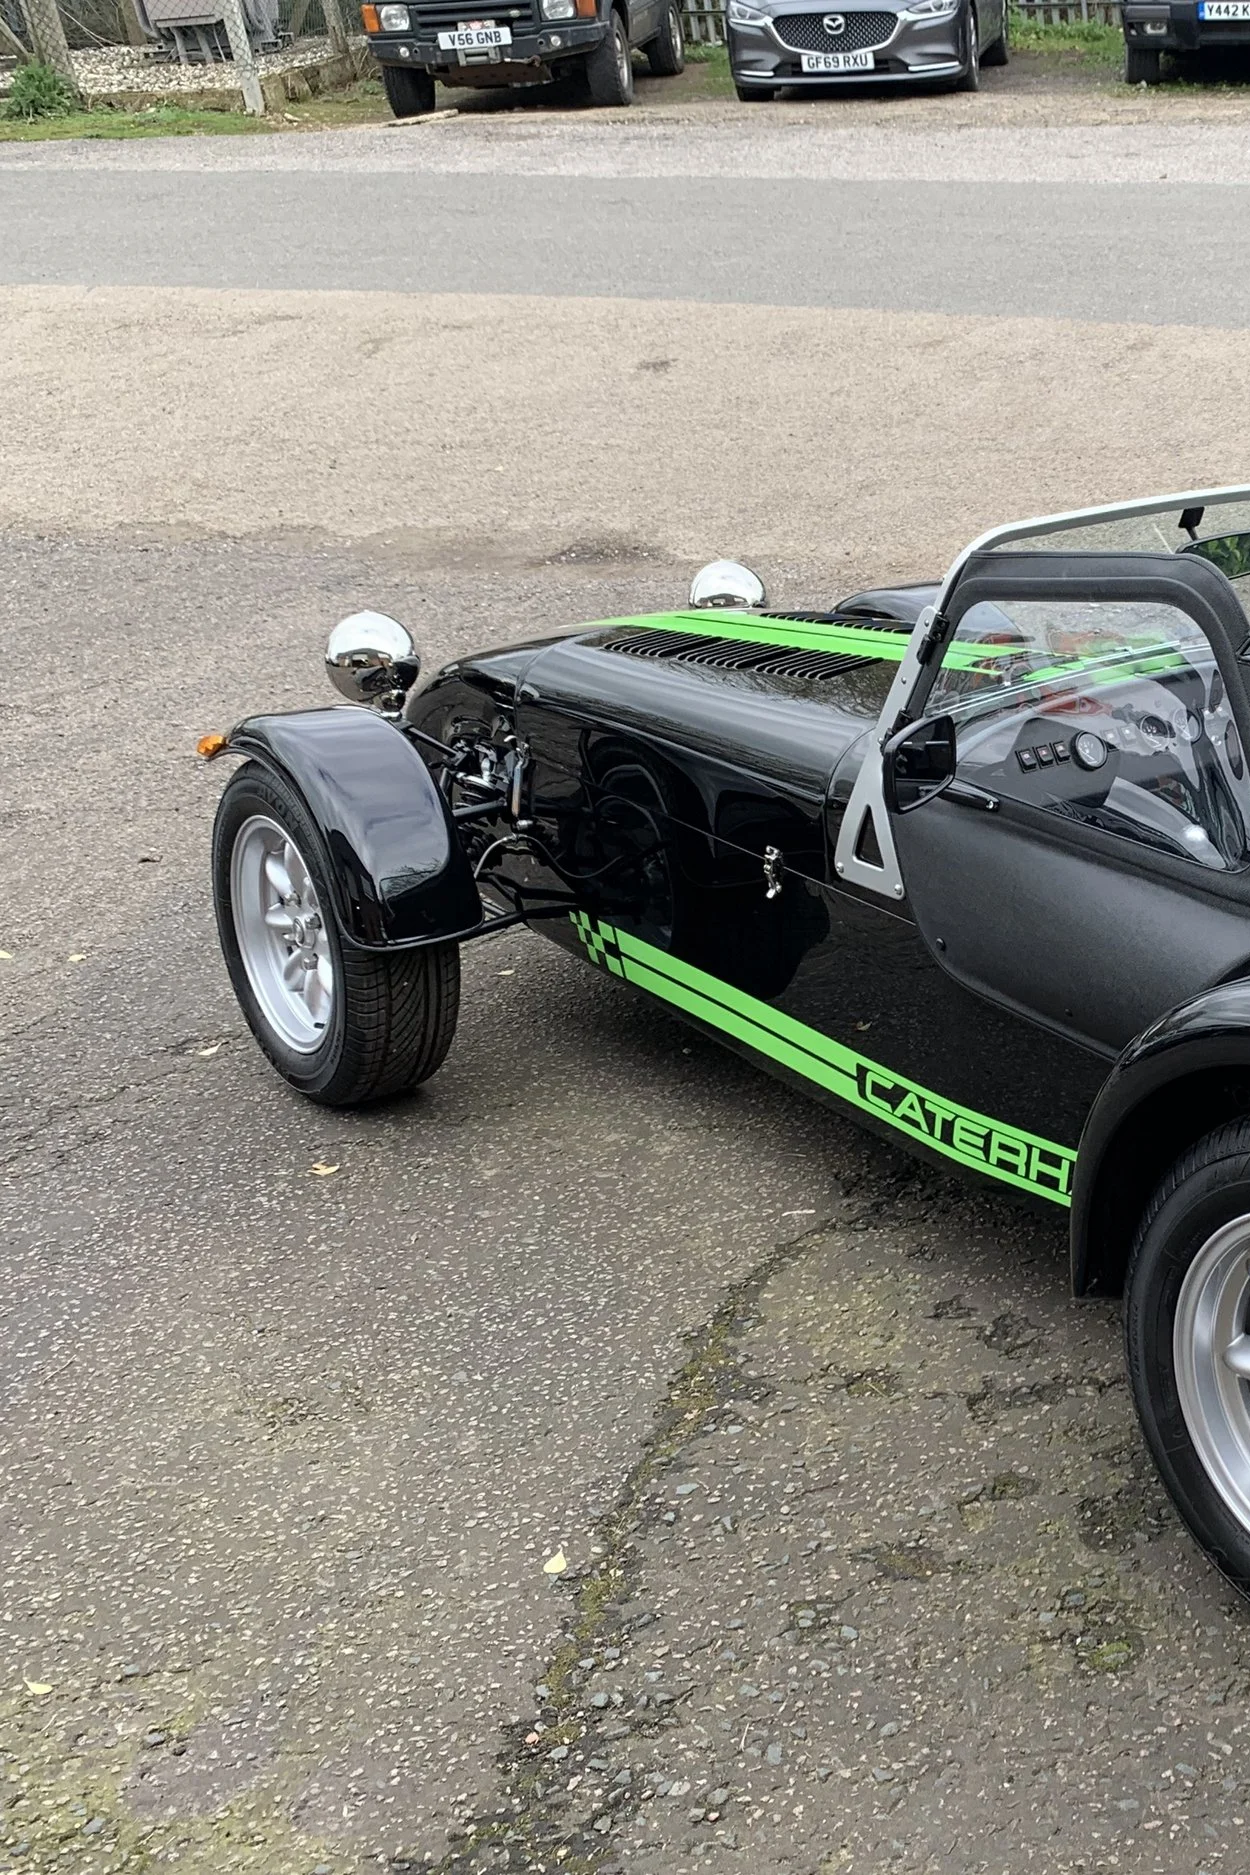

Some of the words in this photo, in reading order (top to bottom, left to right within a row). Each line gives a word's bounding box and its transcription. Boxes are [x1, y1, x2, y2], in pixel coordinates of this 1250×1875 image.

[1207, 4, 1239, 17] Y442
[448, 32, 474, 47] V56
[477, 30, 502, 44] GNB
[807, 55, 840, 70] GF69
[843, 53, 869, 68] RXU
[865, 1070, 1073, 1195] CATERH
